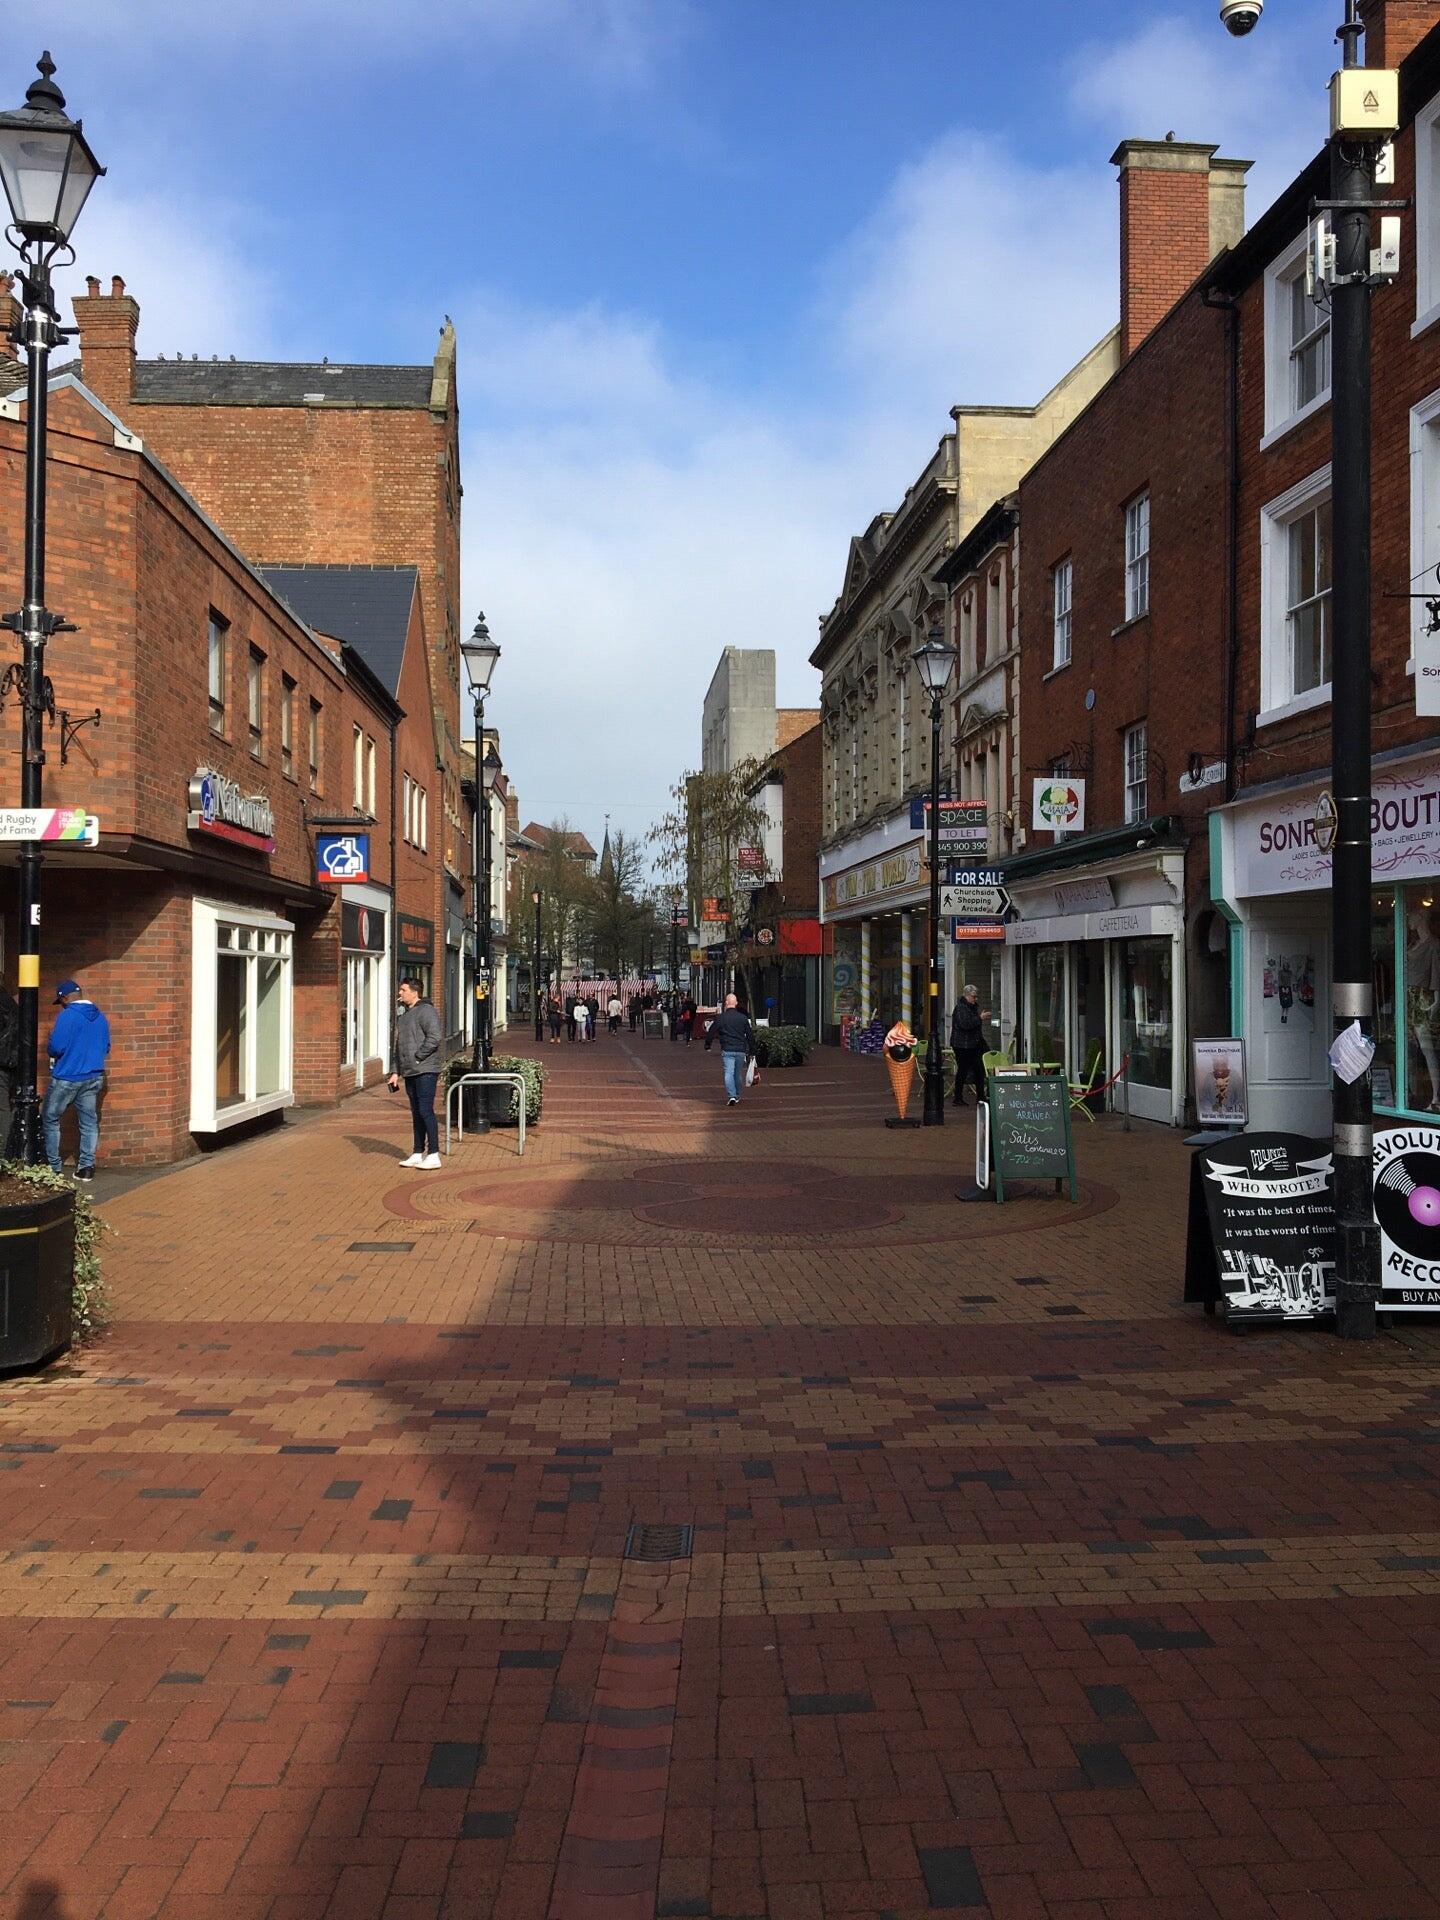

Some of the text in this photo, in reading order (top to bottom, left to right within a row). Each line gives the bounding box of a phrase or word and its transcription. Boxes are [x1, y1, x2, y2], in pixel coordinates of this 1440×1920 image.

[6, 815, 37, 825] Rugby
[9, 826, 37, 835] Fame
[945, 829, 978, 838] TO LET
[954, 842, 970, 851] 900
[972, 841, 987, 850] 390
[1377, 838, 1393, 847] BAGS
[955, 871, 1004, 885] FOR SALE
[953, 888, 995, 896] Churchside
[957, 896, 992, 905] Shopping
[1100, 914, 1139, 931] CAFFETTERIA
[1009, 1130, 1039, 1146] Sales
[1227, 1178, 1320, 1194] WHO WROTE?
[1237, 1208, 1255, 1216] was
[1257, 1207, 1272, 1216] the
[1274, 1206, 1293, 1215] best
[1295, 1205, 1306, 1213] of
[1307, 1205, 1335, 1213] times,
[1235, 1229, 1253, 1237] was
[1254, 1227, 1270, 1236] the
[1272, 1227, 1298, 1235] worst
[1300, 1226, 1310, 1234] of
[1402, 1291, 1425, 1302] BUY
